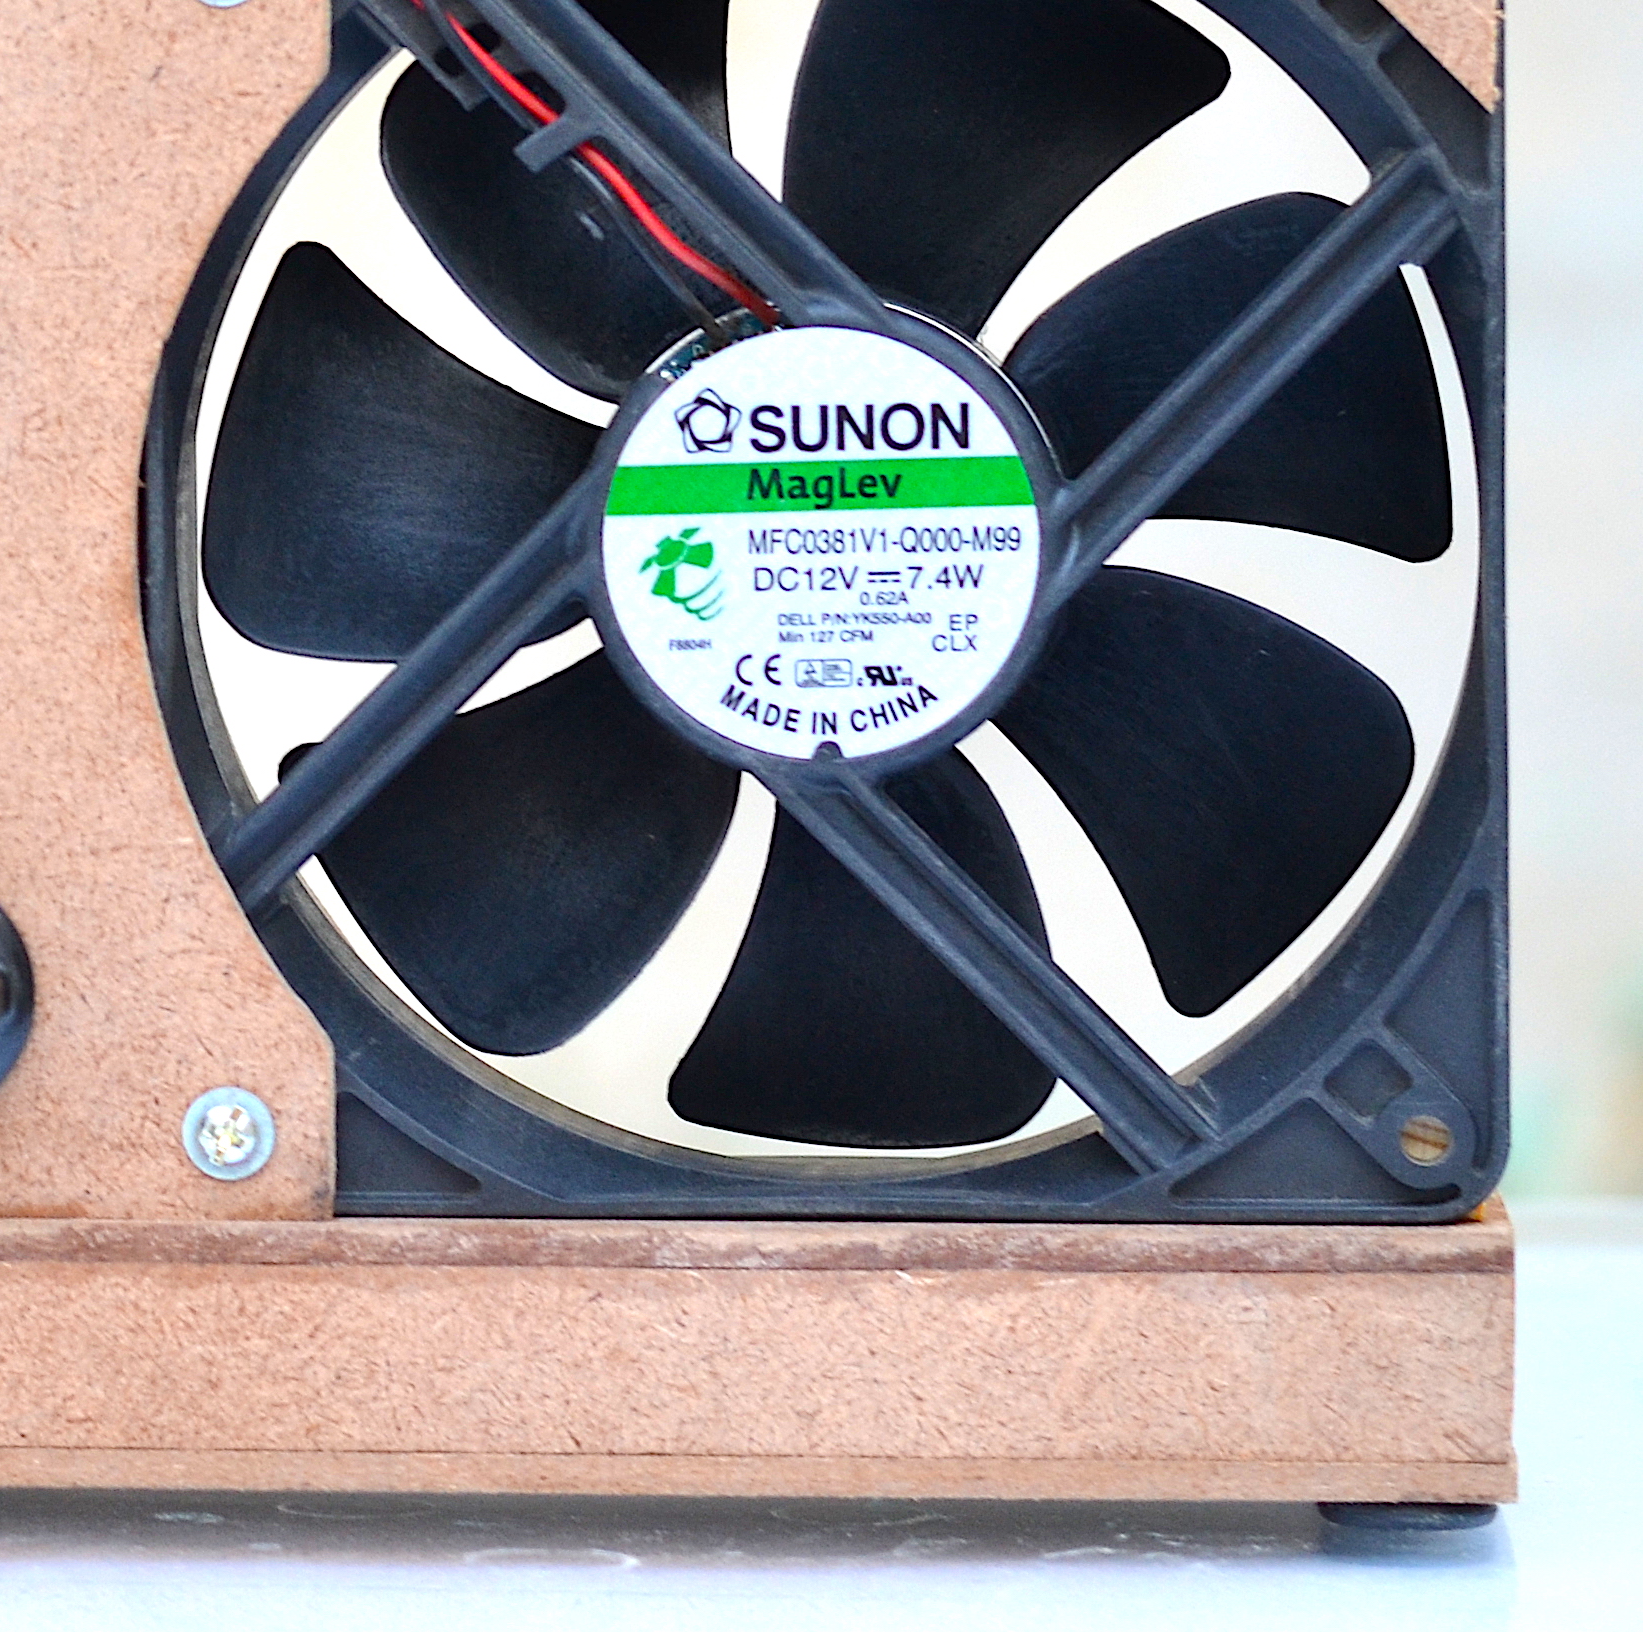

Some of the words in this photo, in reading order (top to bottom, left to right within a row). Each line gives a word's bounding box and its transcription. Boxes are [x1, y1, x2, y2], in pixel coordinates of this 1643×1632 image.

[749, 401, 969, 452] SUNON
[747, 468, 901, 510] MagLev
[747, 526, 1021, 555] MFC0381V1-Q000-M99
[860, 591, 910, 606] 0.62A
[778, 613, 816, 626] DELL
[949, 614, 978, 632] EP
[779, 629, 805, 643] Min
[809, 629, 835, 643] 127
[839, 629, 874, 643] CFM
[932, 633, 978, 652] CLX
[719, 684, 800, 734] MADE
[812, 709, 837, 735] IN
[850, 684, 939, 734] CHINA
